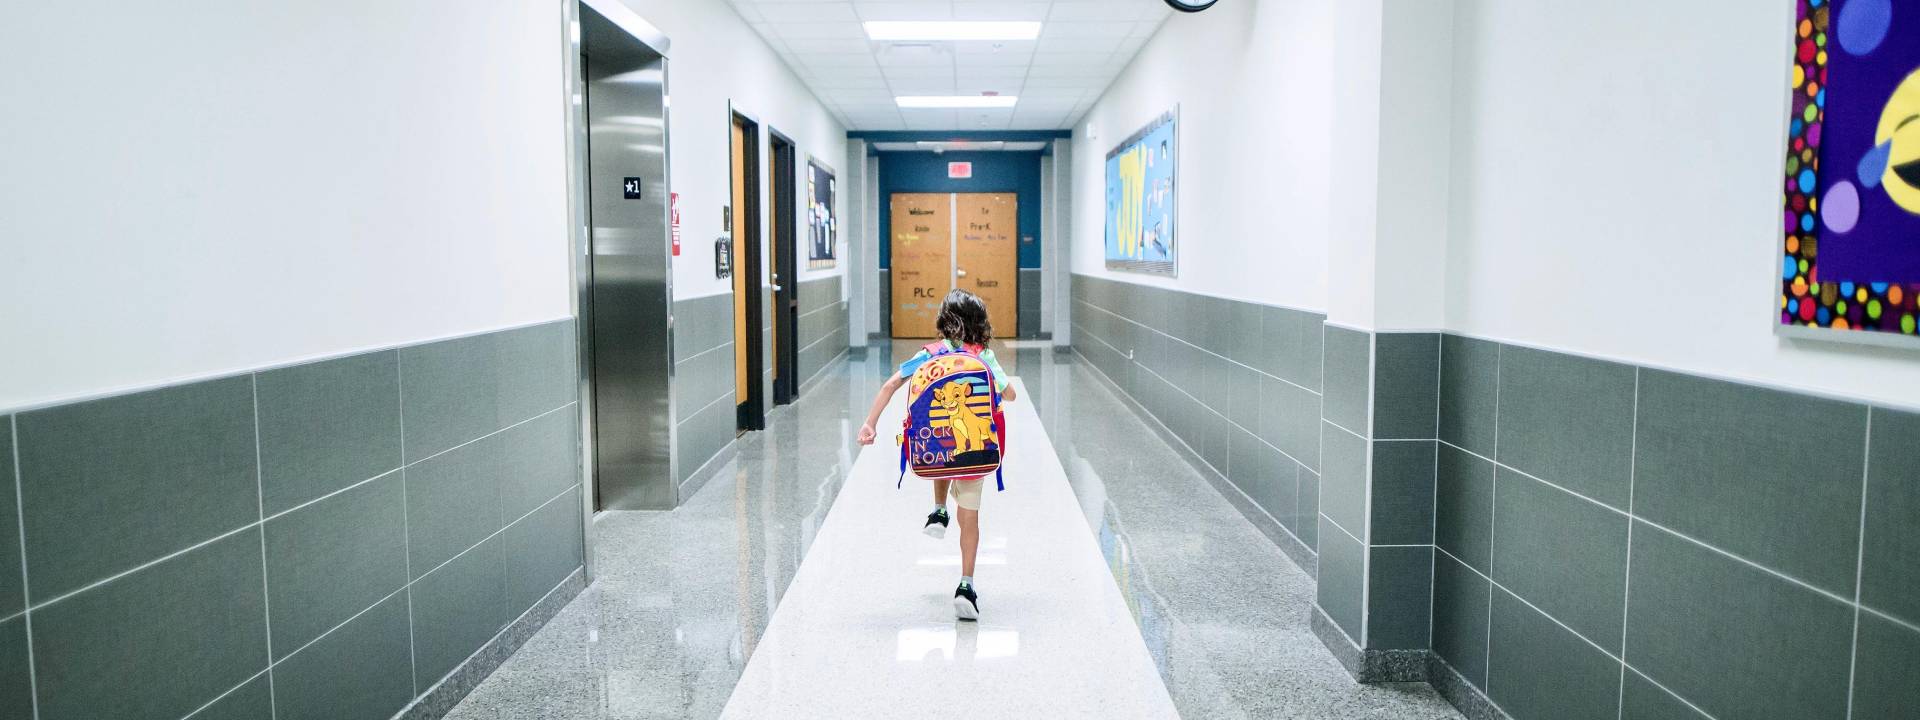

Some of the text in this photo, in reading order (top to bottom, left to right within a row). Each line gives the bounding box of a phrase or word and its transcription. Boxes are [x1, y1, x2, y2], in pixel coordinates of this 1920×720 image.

[634, 180, 639, 193] 1
[1116, 143, 1147, 258] JOY
[913, 287, 935, 298] PLC
[914, 426, 952, 440] OCK
[912, 451, 955, 465] ROAR
